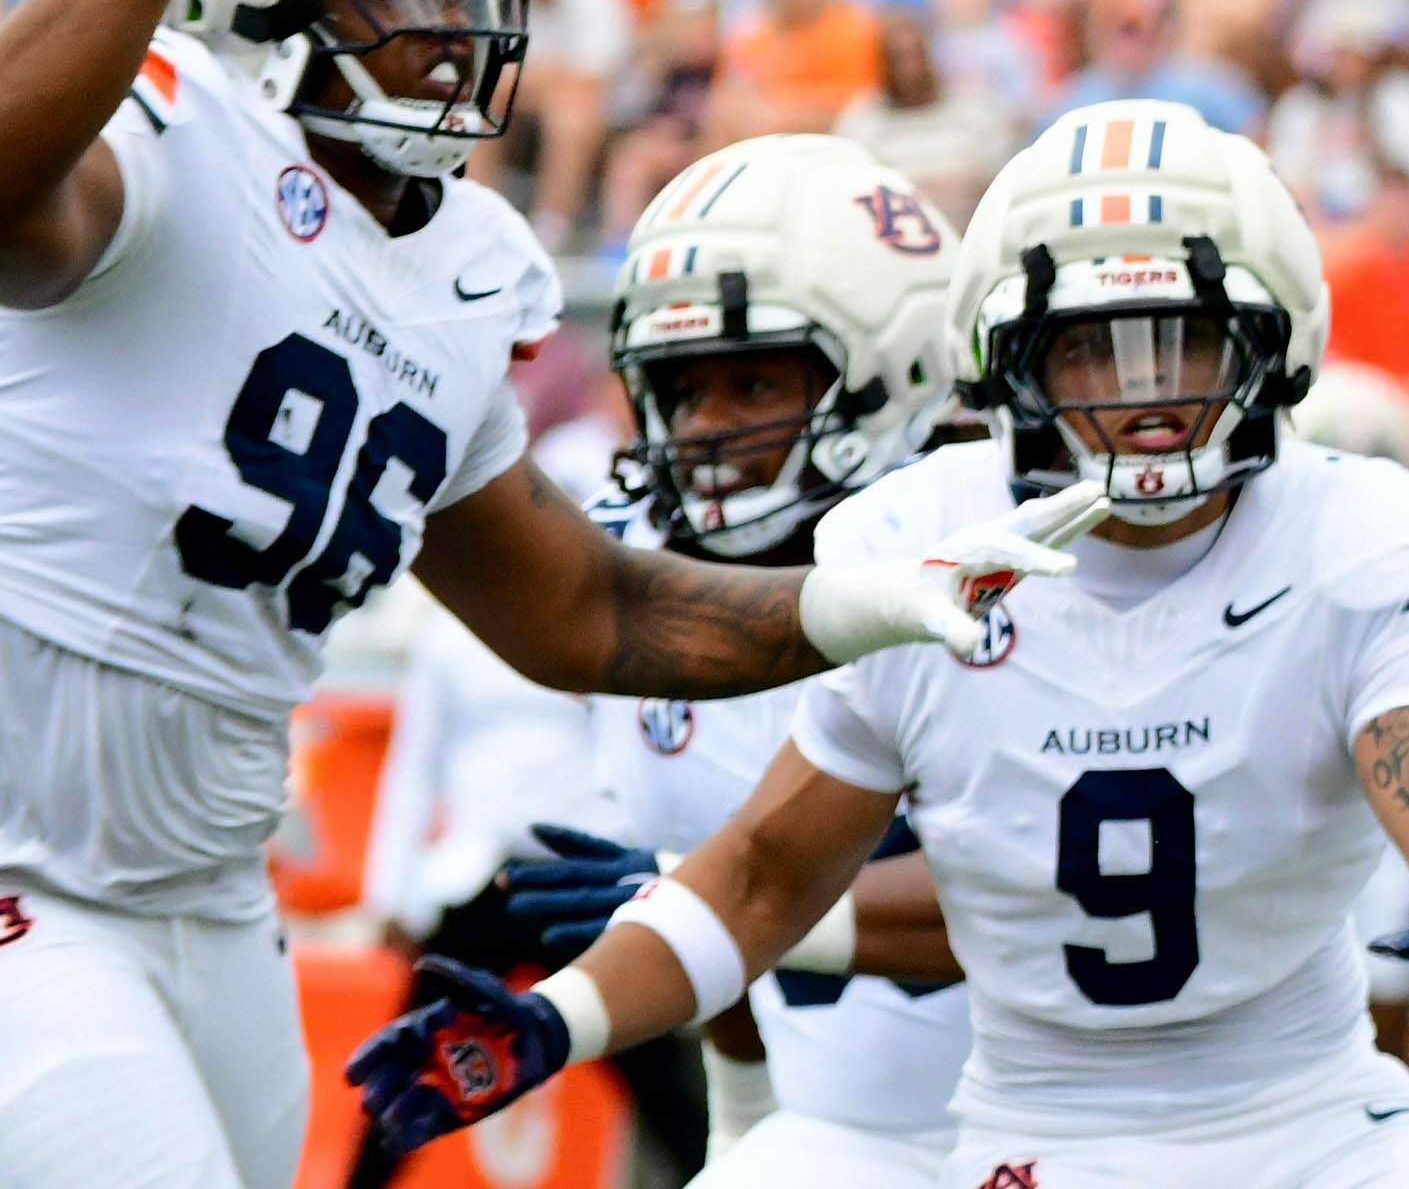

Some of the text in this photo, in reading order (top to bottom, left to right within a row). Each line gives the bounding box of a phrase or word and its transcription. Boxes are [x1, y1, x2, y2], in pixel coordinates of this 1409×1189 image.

[1097, 271, 1178, 286] TIGERS
[323, 309, 440, 399] AUBURN
[174, 331, 448, 635] 96
[1040, 717, 1210, 755] AUBURN
[1056, 767, 1200, 1005] 9
